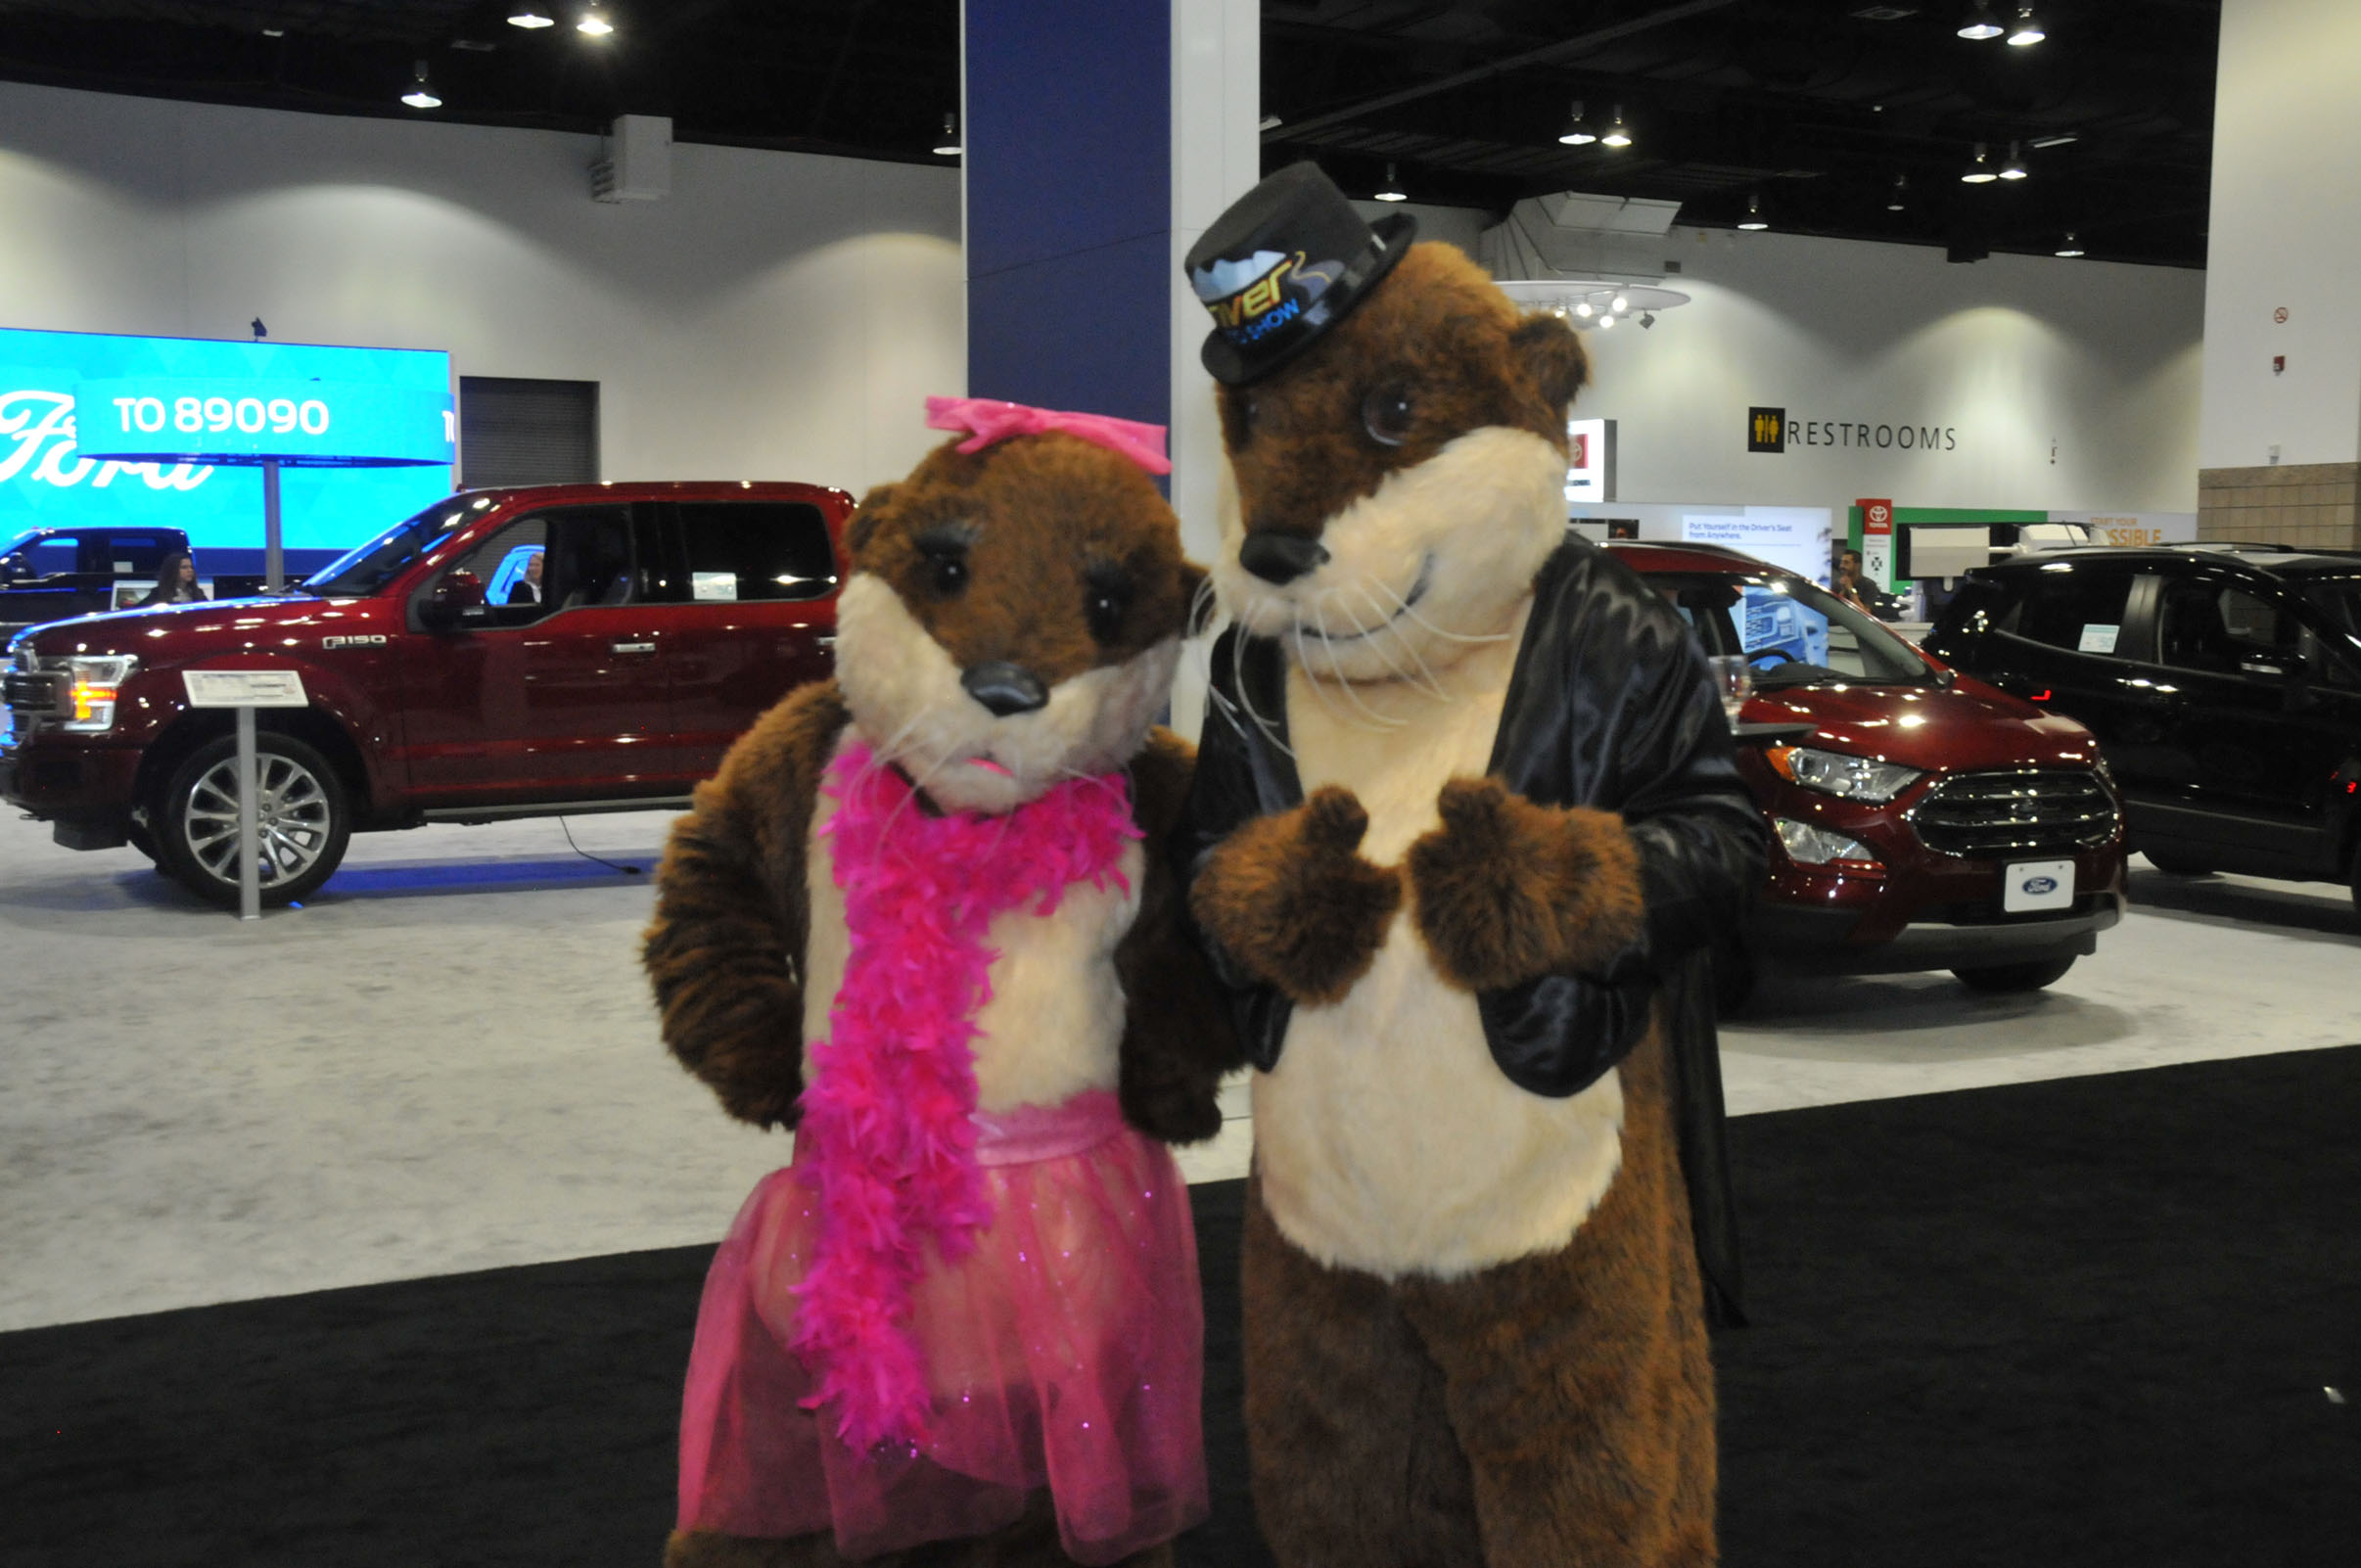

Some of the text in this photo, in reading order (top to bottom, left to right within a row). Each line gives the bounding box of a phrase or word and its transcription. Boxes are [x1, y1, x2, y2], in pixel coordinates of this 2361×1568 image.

[113, 397, 330, 435] TO 89090
[1787, 421, 1956, 450] RESTROOMS
[2106, 529, 2161, 547] SSIBLE
